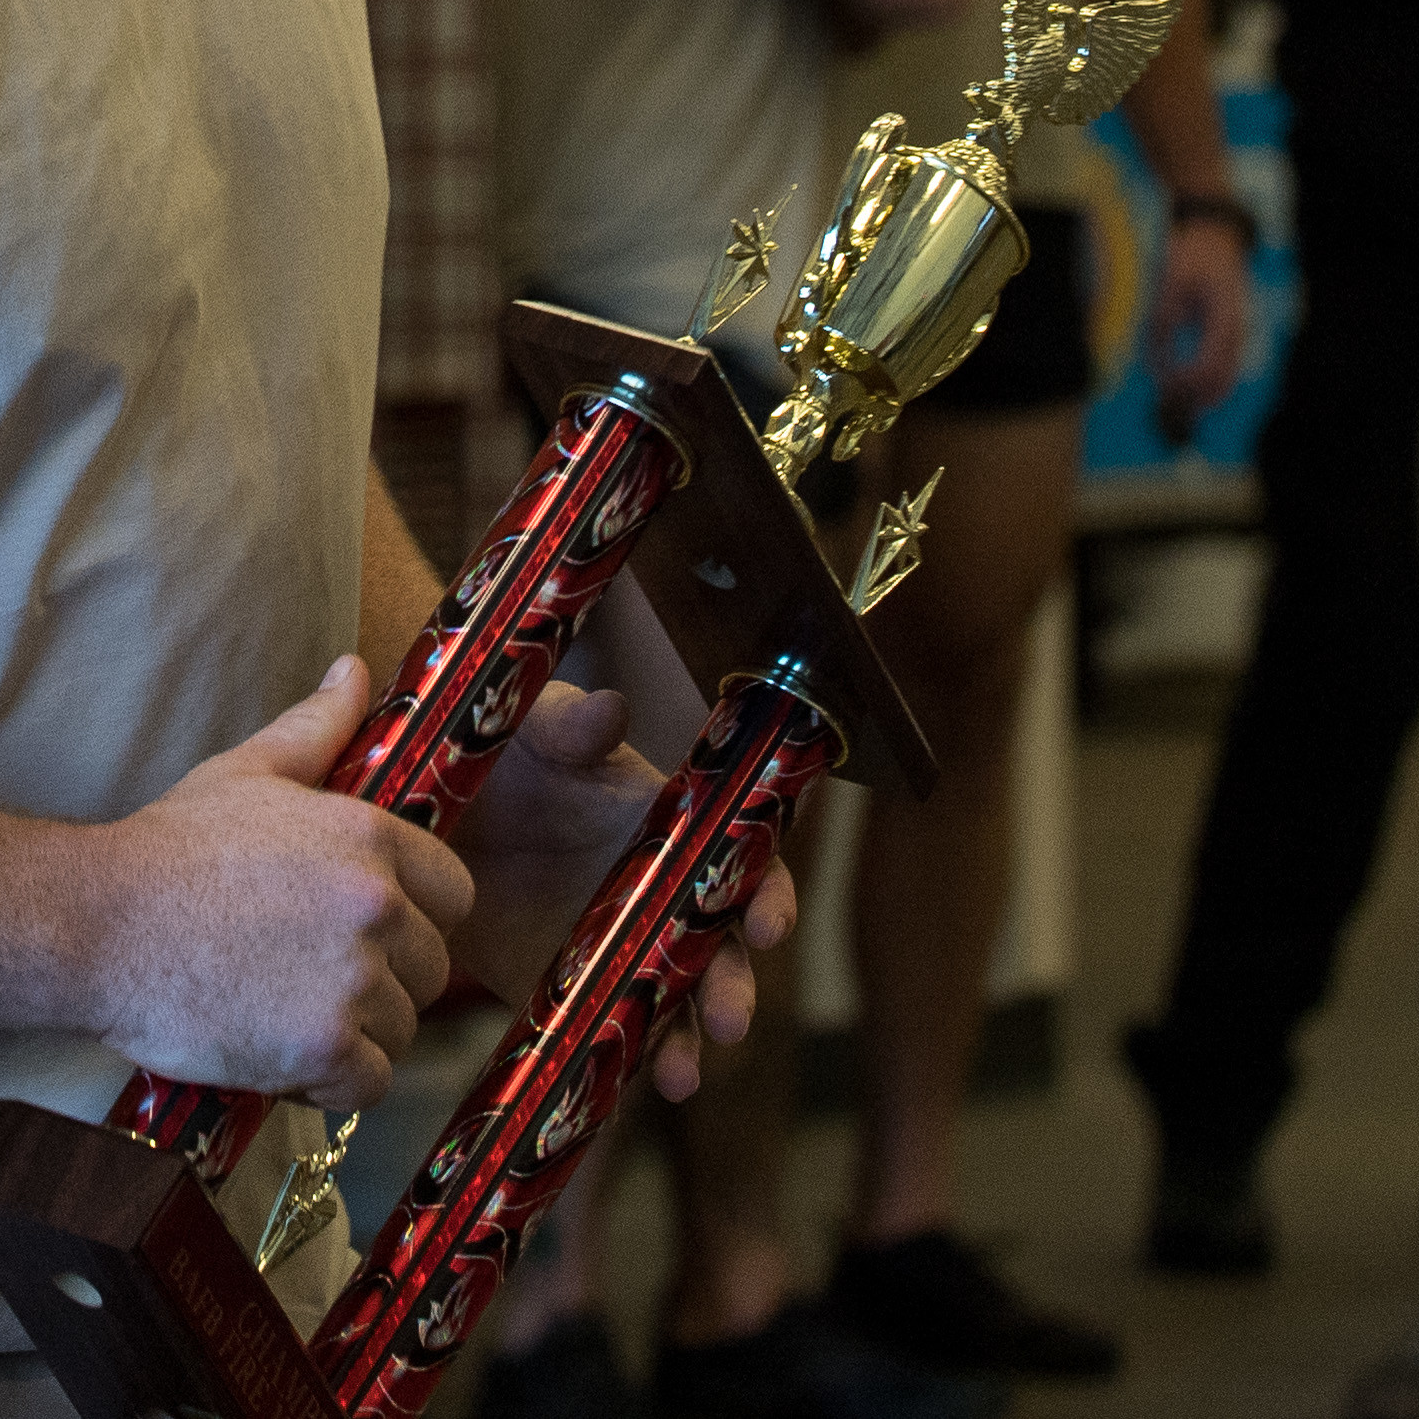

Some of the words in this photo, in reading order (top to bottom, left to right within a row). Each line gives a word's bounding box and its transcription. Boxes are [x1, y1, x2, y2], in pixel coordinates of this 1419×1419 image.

[169, 1247, 223, 1337] BAFB
[218, 1329, 269, 1412] FIRE
[237, 1302, 328, 1419] CHAMP
